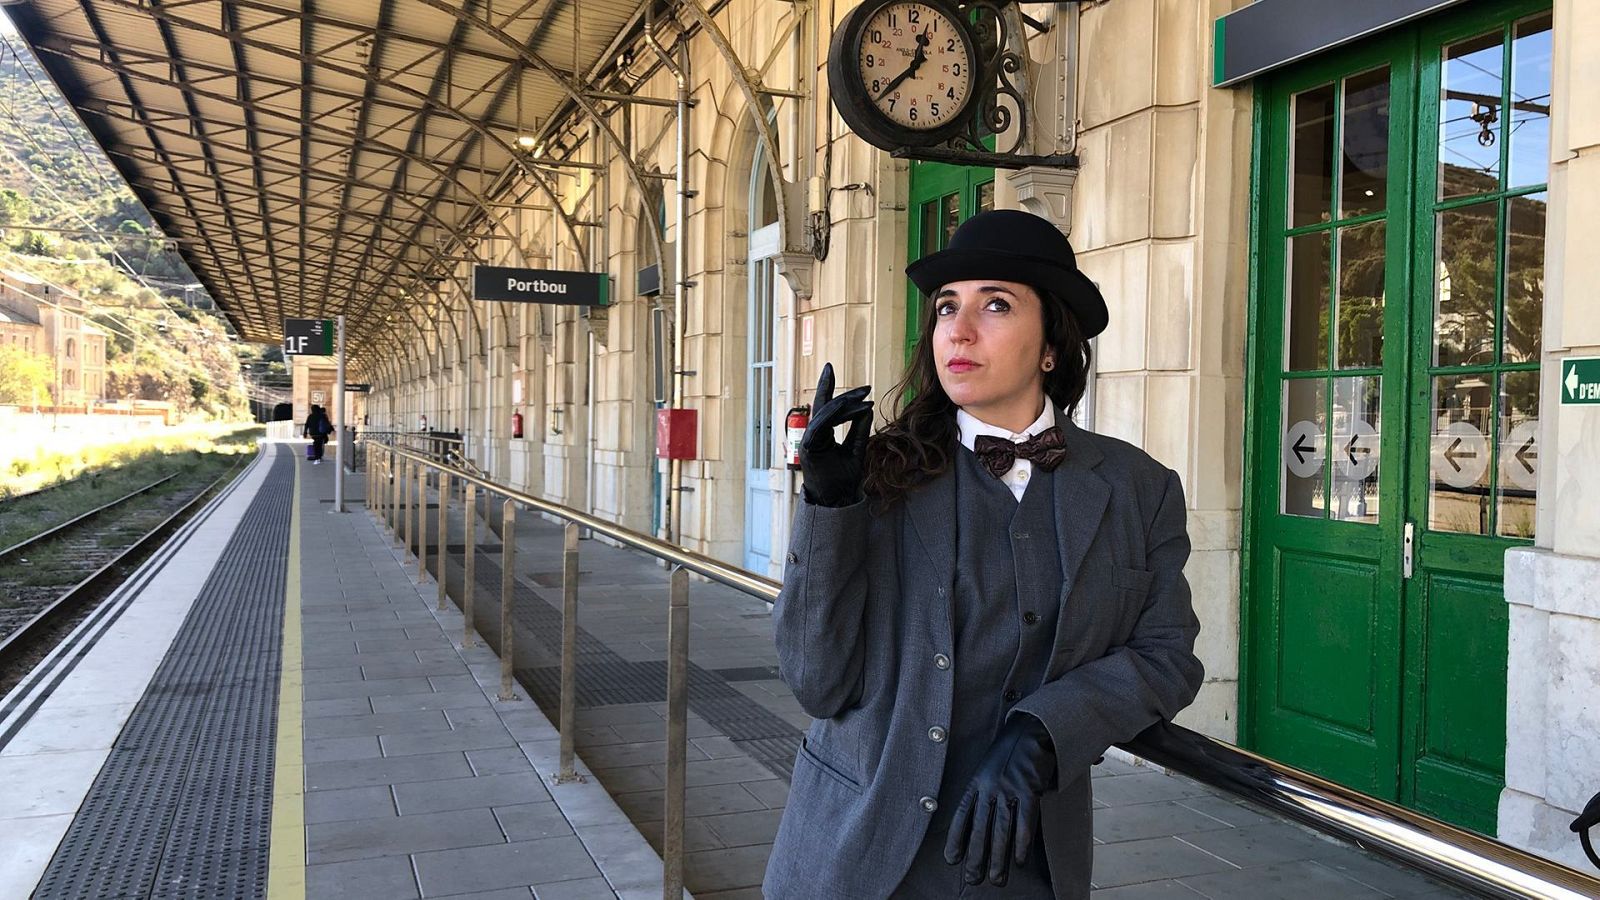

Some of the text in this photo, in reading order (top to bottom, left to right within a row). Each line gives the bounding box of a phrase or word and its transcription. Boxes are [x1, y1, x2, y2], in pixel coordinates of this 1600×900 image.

[888, 14, 896, 28] 11
[908, 10, 920, 24] 12
[934, 20, 937, 32] 1
[870, 30, 882, 44] 10
[882, 40, 892, 48] 22
[947, 39, 954, 52] 2
[866, 54, 874, 68] 9
[953, 64, 960, 76] 3
[872, 80, 880, 92] 8
[947, 88, 954, 100] 4
[888, 99, 896, 112] 7
[932, 104, 939, 116] 5
[910, 108, 918, 120] 6
[508, 278, 566, 294] Portbou
[286, 336, 308, 353] 1F
